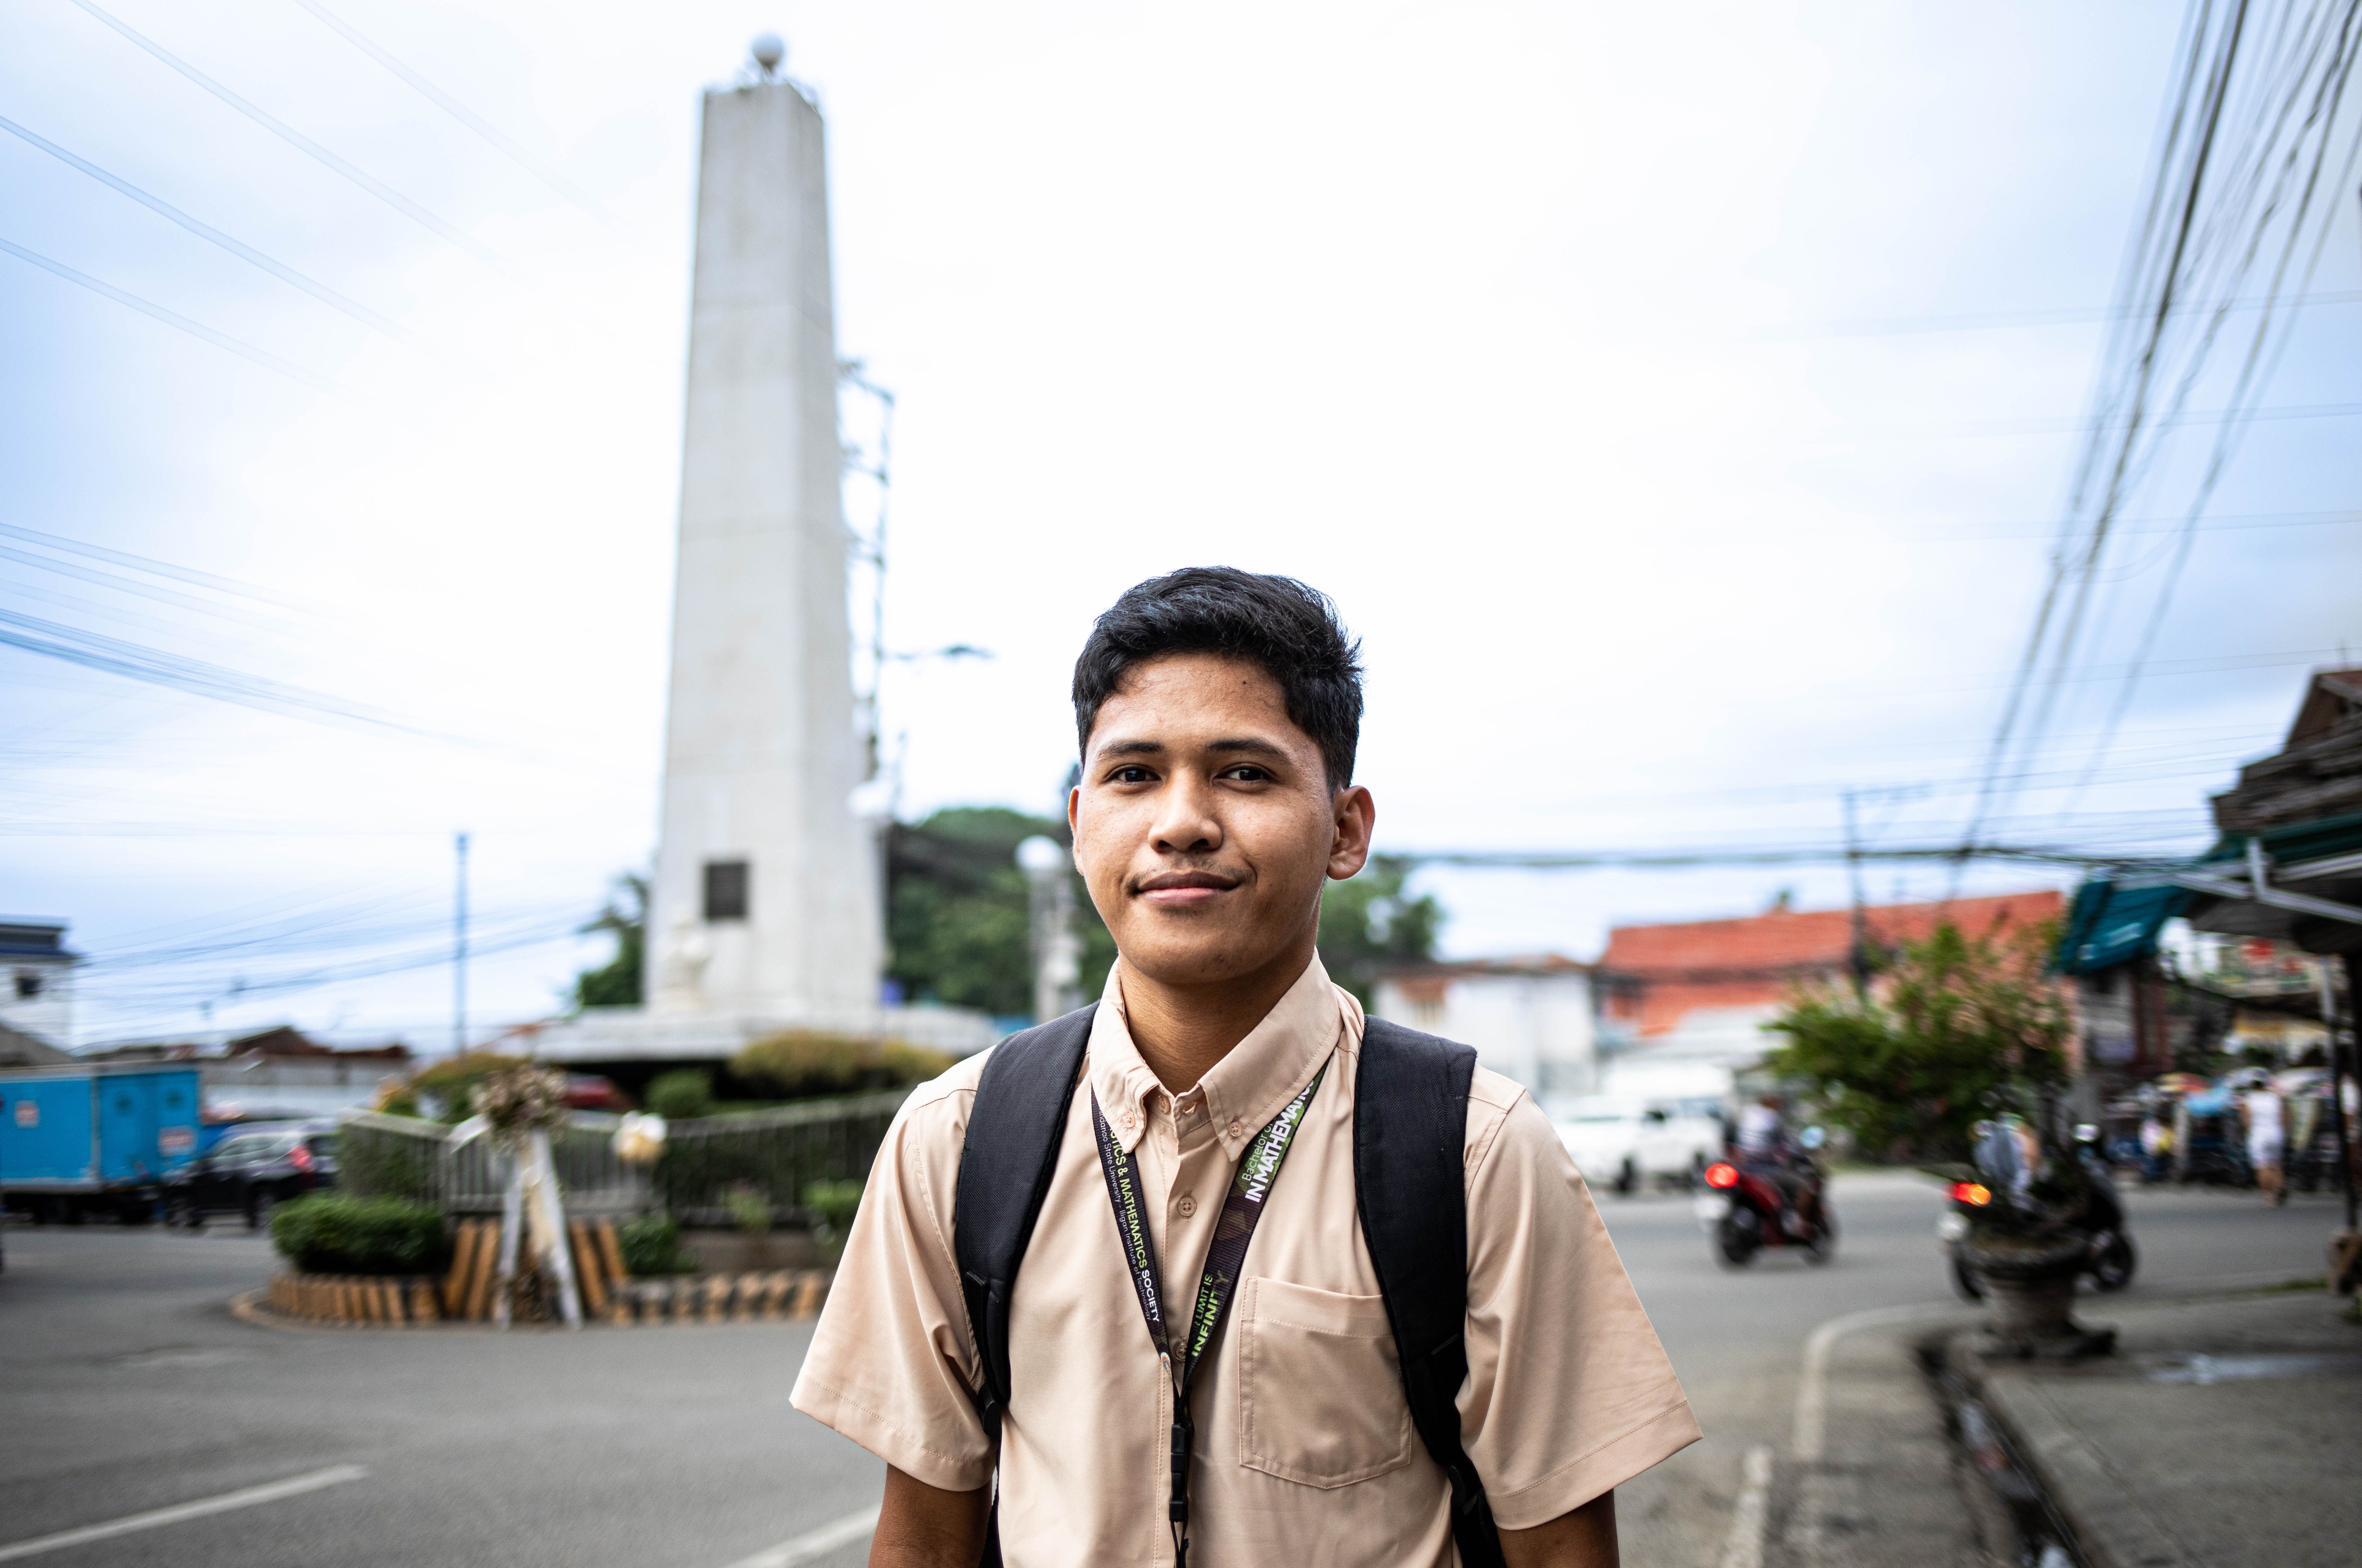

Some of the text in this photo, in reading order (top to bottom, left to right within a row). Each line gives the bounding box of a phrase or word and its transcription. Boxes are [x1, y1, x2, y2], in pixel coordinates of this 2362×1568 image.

[1098, 1108, 1108, 1142] indanao
[1104, 1143, 1113, 1164] State
[1241, 1133, 1267, 1181] Bachelor
[1109, 1166, 1121, 1202] University
[1117, 1167, 1128, 1178] &
[1245, 1181, 1266, 1203] IN
[1119, 1210, 1128, 1232] Iligan
[1119, 1178, 1147, 1268] MATHEMATICS
[1125, 1233, 1136, 1264] Institute
[1134, 1266, 1141, 1275] of
[1137, 1276, 1151, 1321] Technology
[1142, 1269, 1159, 1322] SOCIETY
[1195, 1274, 1213, 1320] LIMIT IS
[1191, 1270, 1229, 1357] INFINITY
